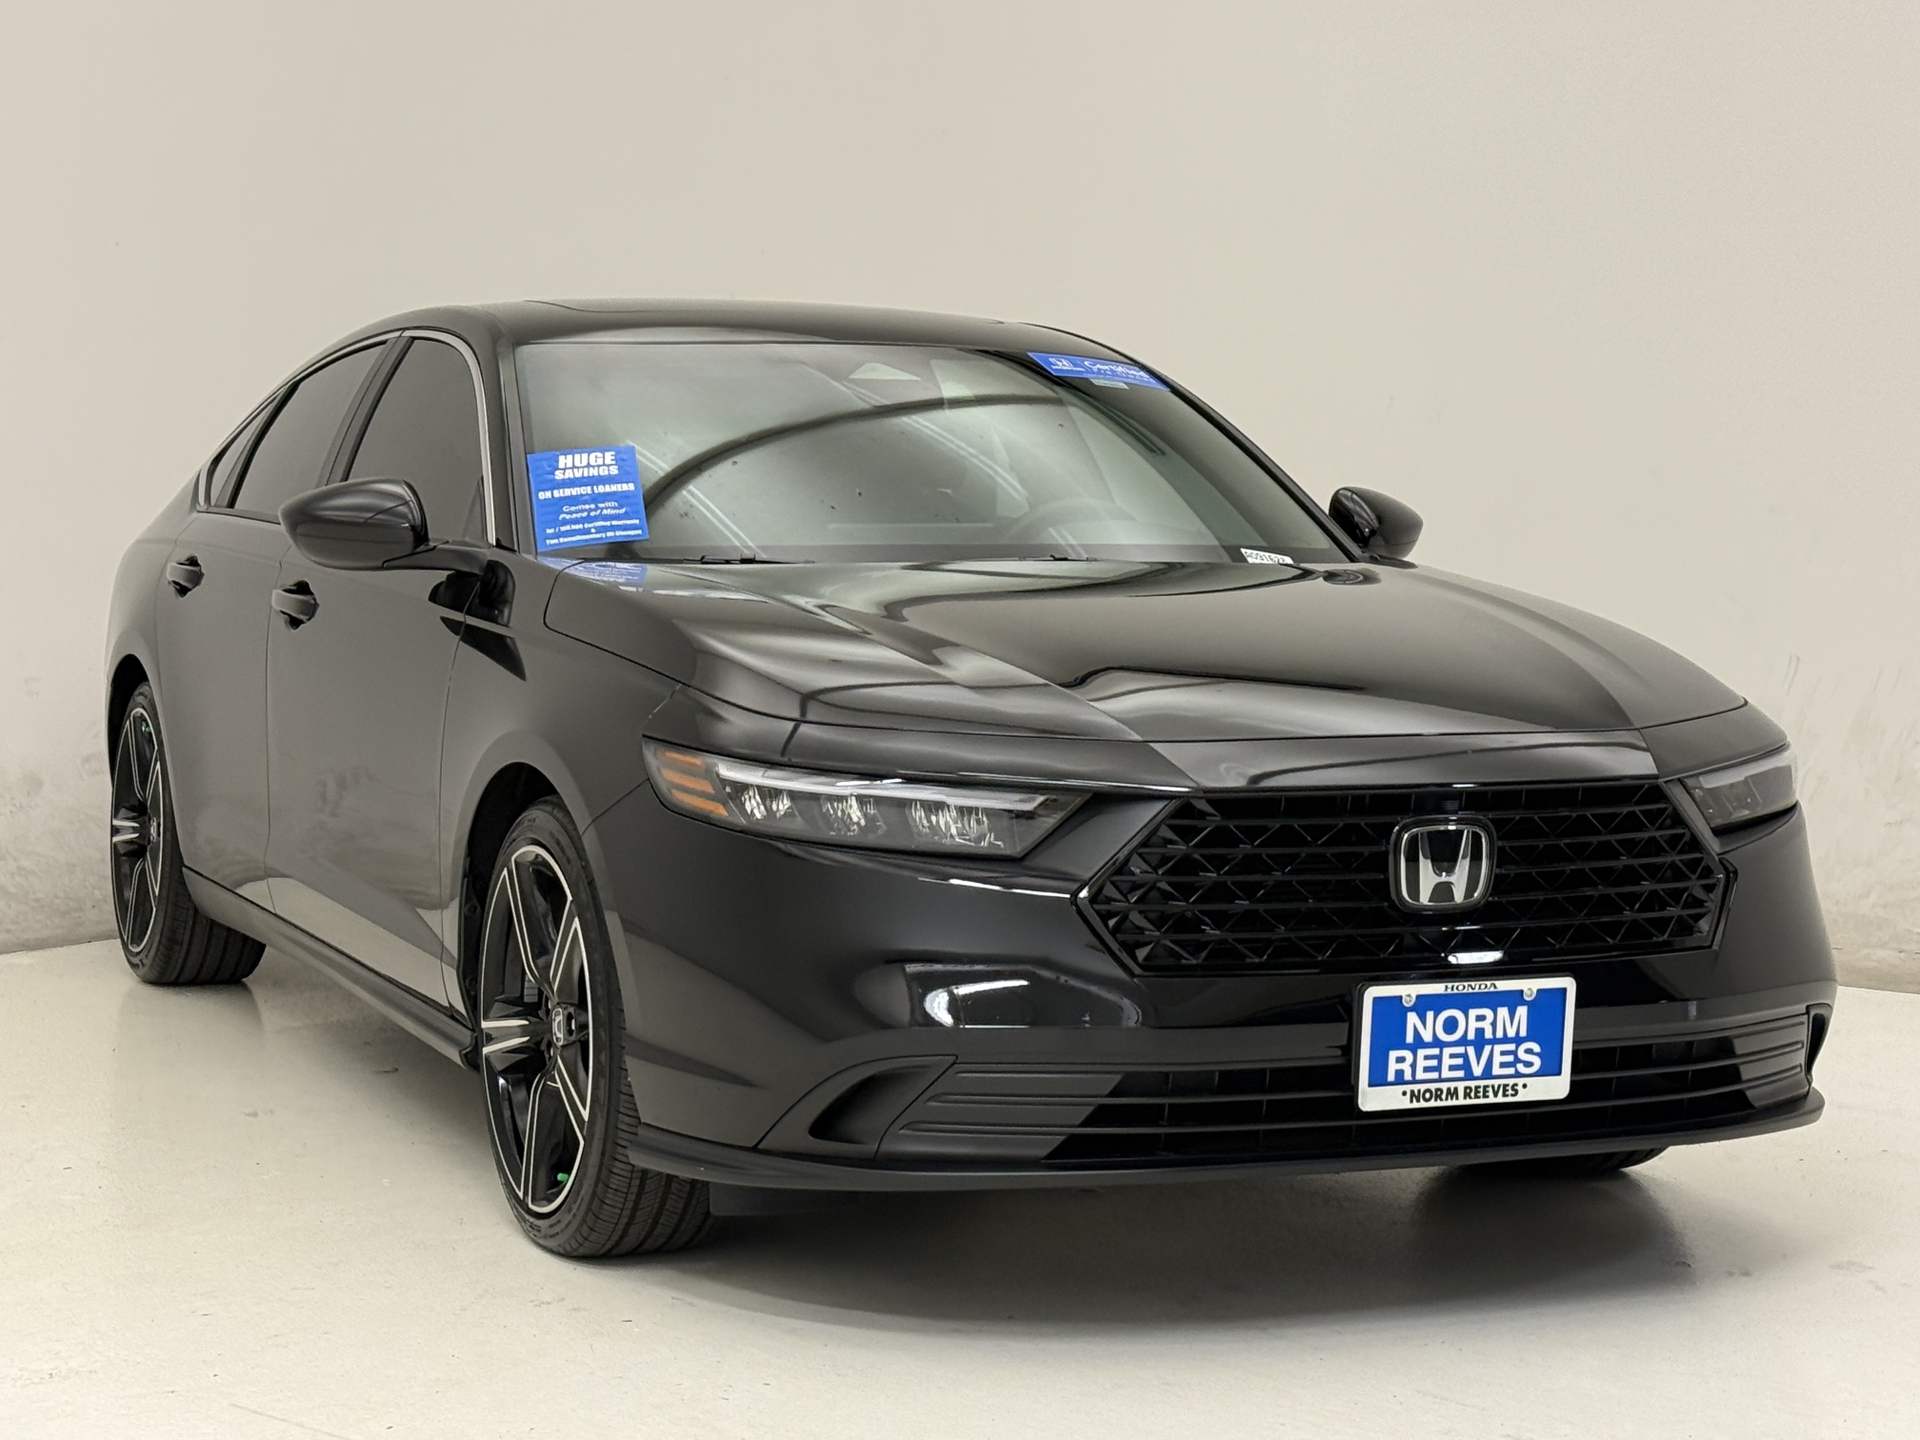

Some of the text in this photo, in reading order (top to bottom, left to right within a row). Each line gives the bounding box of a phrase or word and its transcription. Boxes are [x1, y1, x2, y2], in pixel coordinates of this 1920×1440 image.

[558, 451, 616, 469] HUGE
[554, 465, 619, 480] SAVINGS
[538, 482, 635, 500] ON SERVICE LOANERS
[559, 507, 627, 520] Peace of Mind
[562, 503, 596, 512] Comes
[1443, 982, 1498, 993] HONDA
[1405, 1005, 1528, 1044] NORM
[1387, 1041, 1542, 1082] REEVES
[1409, 1083, 1519, 1104] NORM REEVES
